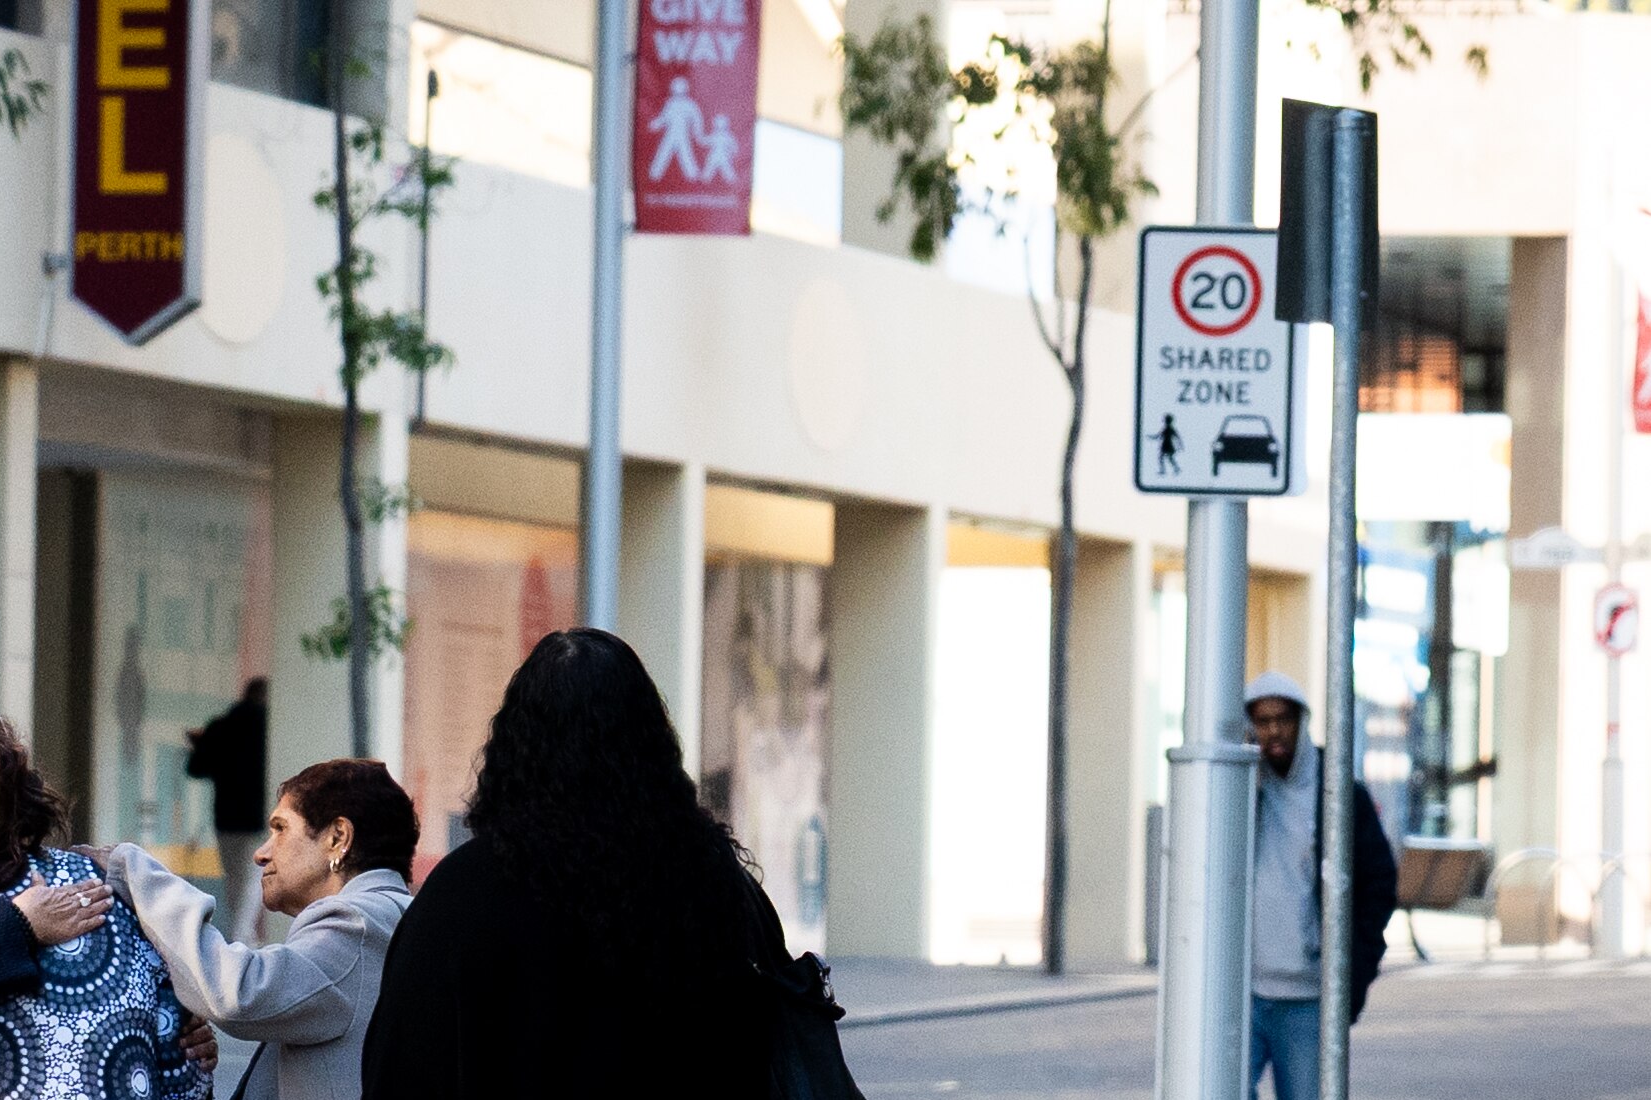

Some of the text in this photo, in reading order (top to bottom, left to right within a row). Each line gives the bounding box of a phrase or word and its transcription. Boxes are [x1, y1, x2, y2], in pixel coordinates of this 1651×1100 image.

[651, 0, 745, 23] GIVE
[654, 30, 744, 64] WAY
[74, 231, 185, 261] PERTH
[1190, 271, 1246, 311] 20
[1159, 346, 1272, 373] SHARED
[1176, 378, 1251, 404] ZONE
